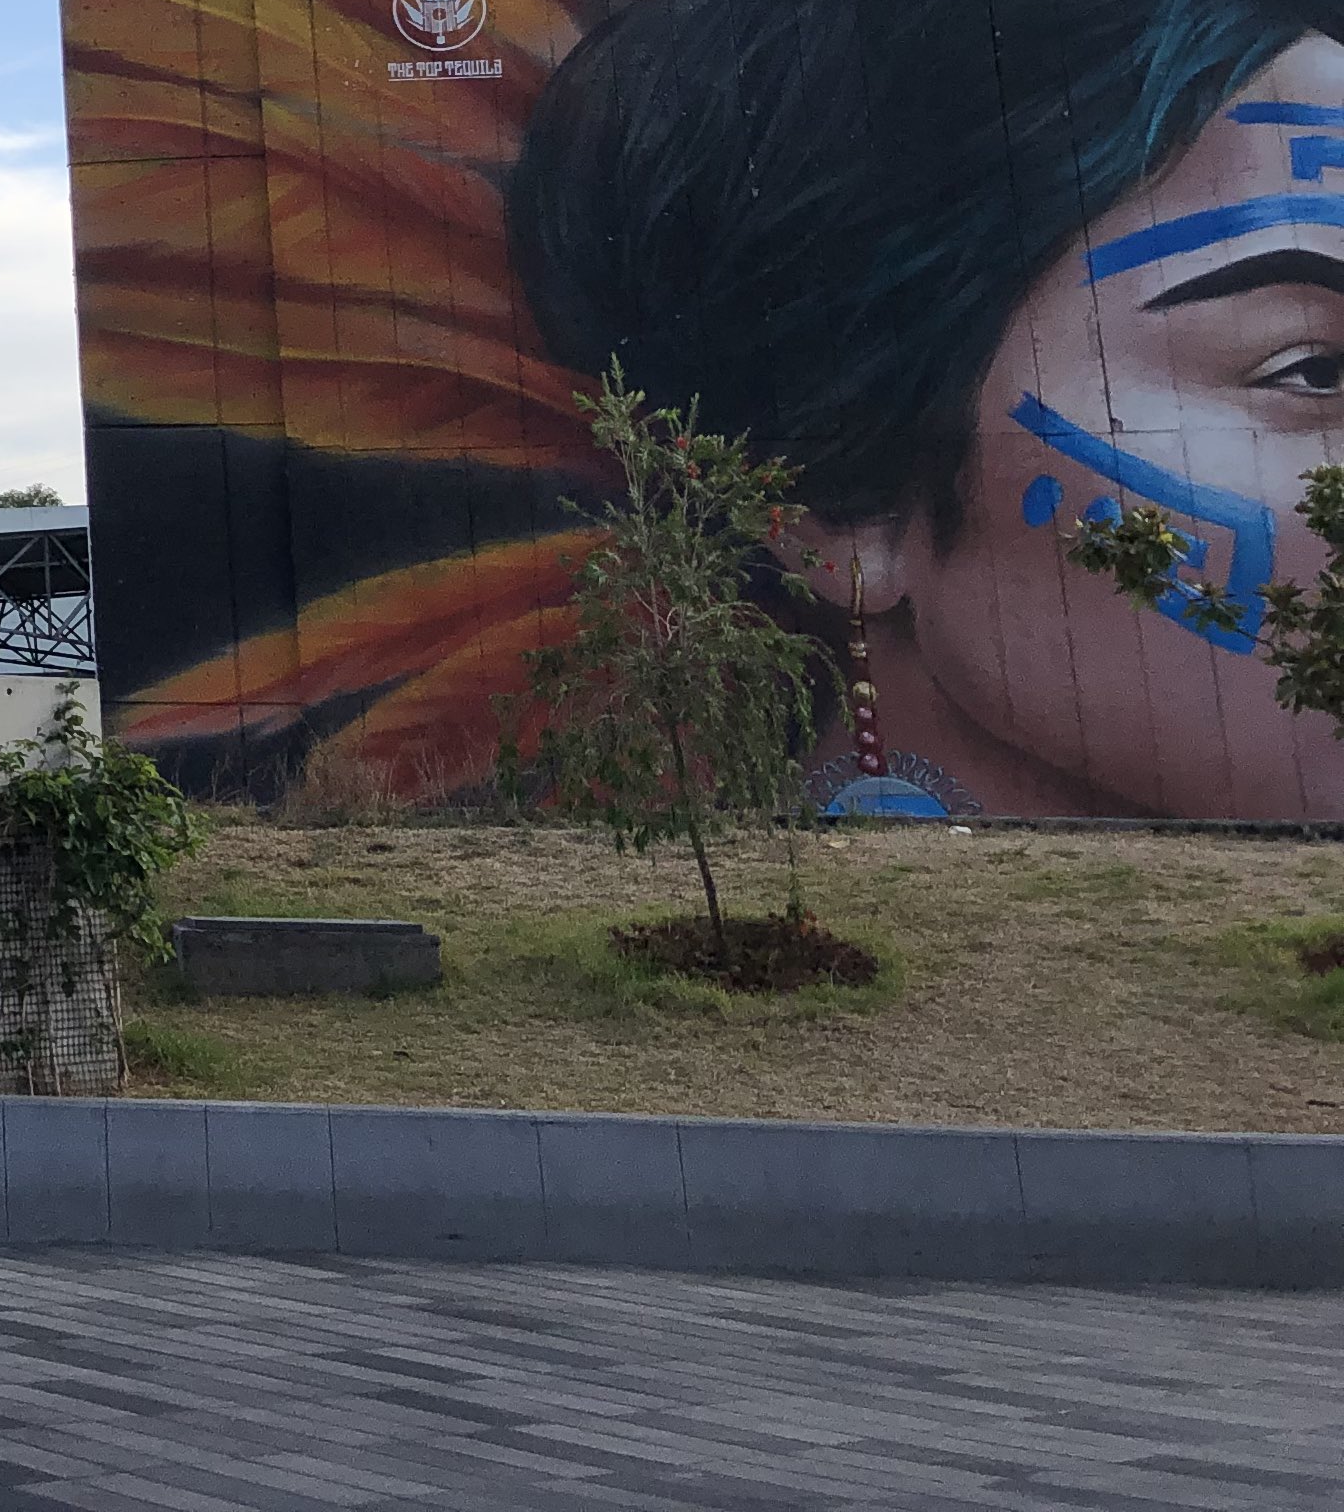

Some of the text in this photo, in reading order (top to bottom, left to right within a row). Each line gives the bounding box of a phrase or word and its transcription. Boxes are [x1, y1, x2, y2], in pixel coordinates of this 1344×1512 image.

[387, 59, 502, 78] THE TOP TEQUILA
